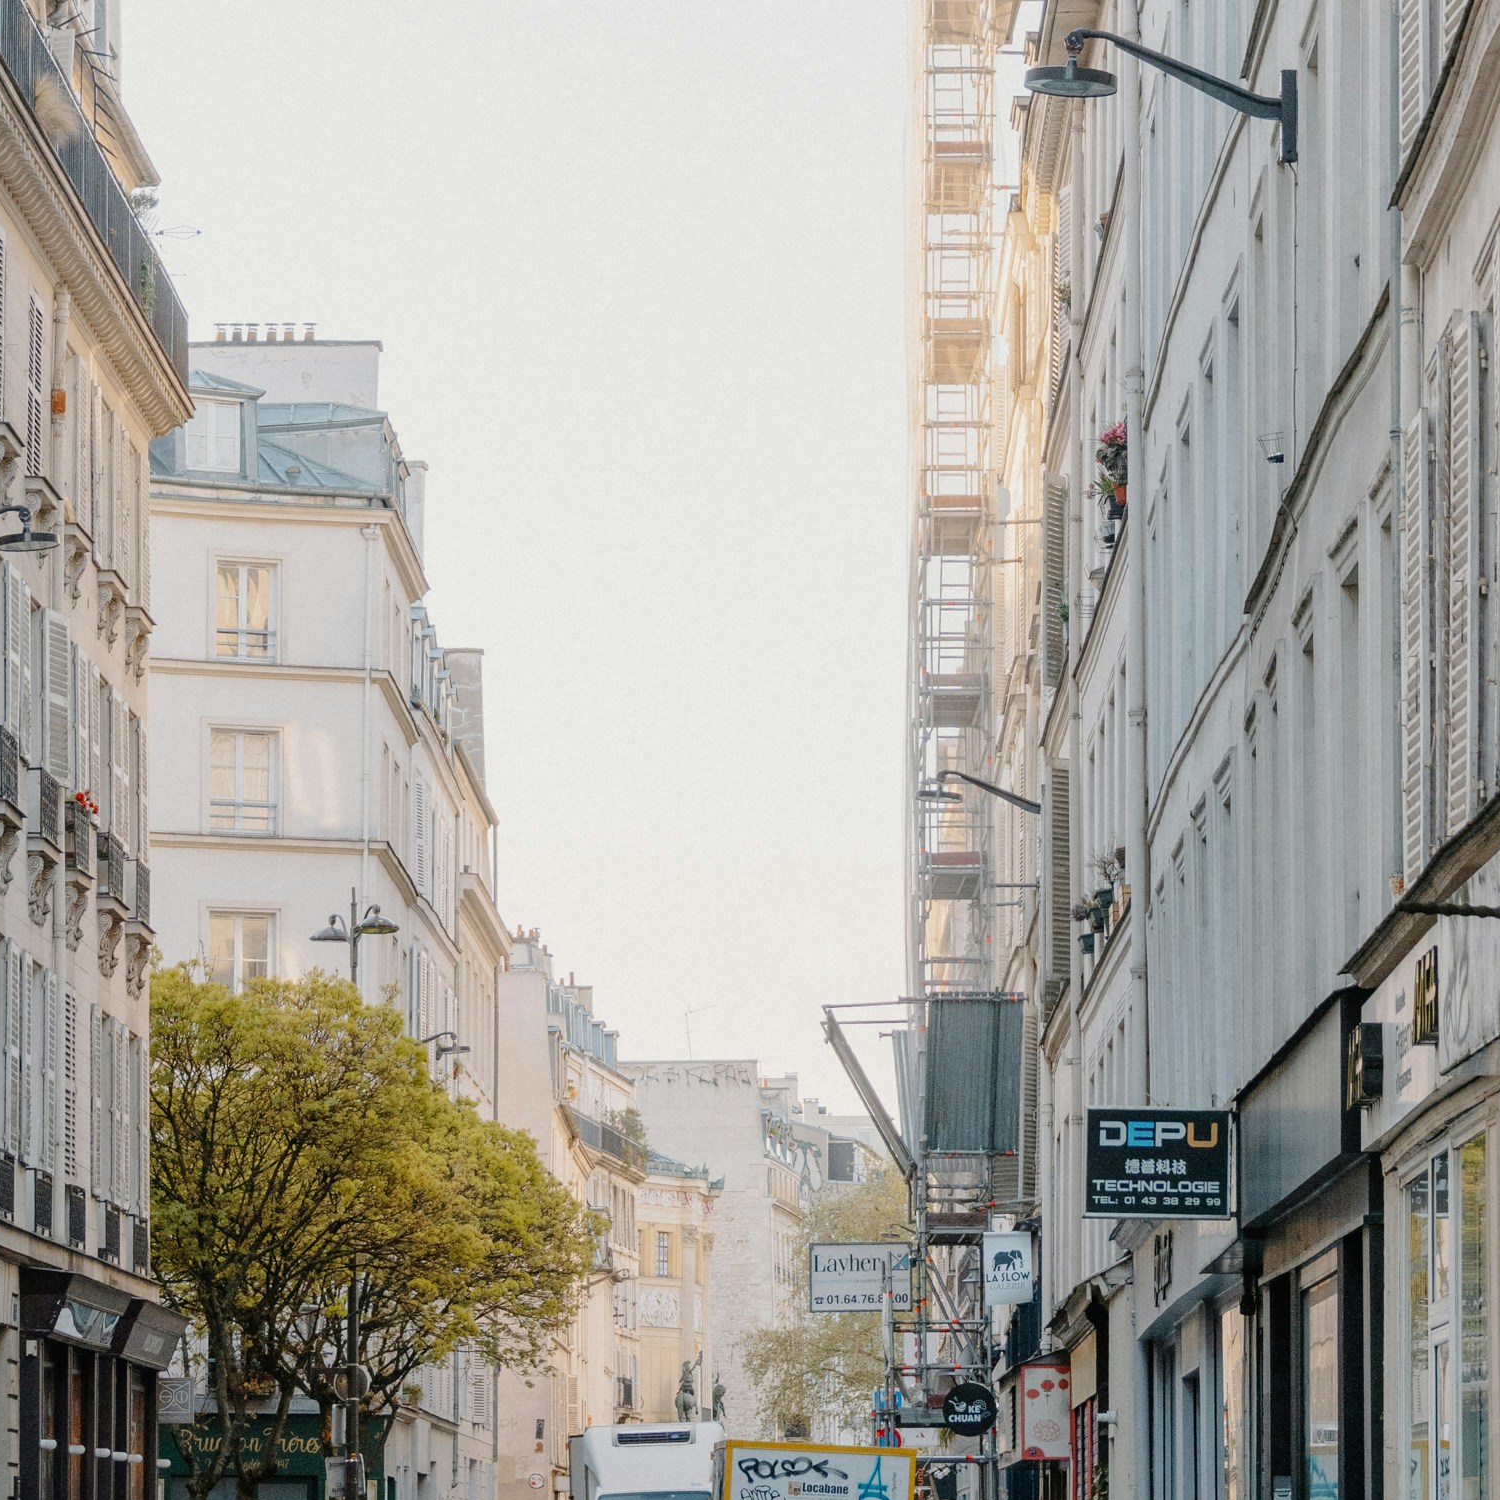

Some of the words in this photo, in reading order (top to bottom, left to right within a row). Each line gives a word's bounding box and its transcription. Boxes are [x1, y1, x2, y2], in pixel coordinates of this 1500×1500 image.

[1099, 1121, 1218, 1148] DEPU
[1092, 1179, 1220, 1193] TECHNOLOGIE
[1092, 1195, 1118, 1204] TEL:
[1124, 1196, 1135, 1204] 01
[1141, 1196, 1157, 1205] 43
[1162, 1196, 1179, 1205] 38
[1185, 1197, 1200, 1205] 29
[1206, 1197, 1221, 1206] 99
[814, 1254, 881, 1276] Layher
[986, 1273, 999, 1283] LA
[1001, 1271, 1030, 1282] SLOW
[989, 1282, 1027, 1291] GALERIE
[827, 1293, 909, 1304] 01.64.76.8.00
[968, 1405, 981, 1414] KE
[948, 1414, 981, 1423] CHUAN
[802, 1481, 849, 1495] Locabane
